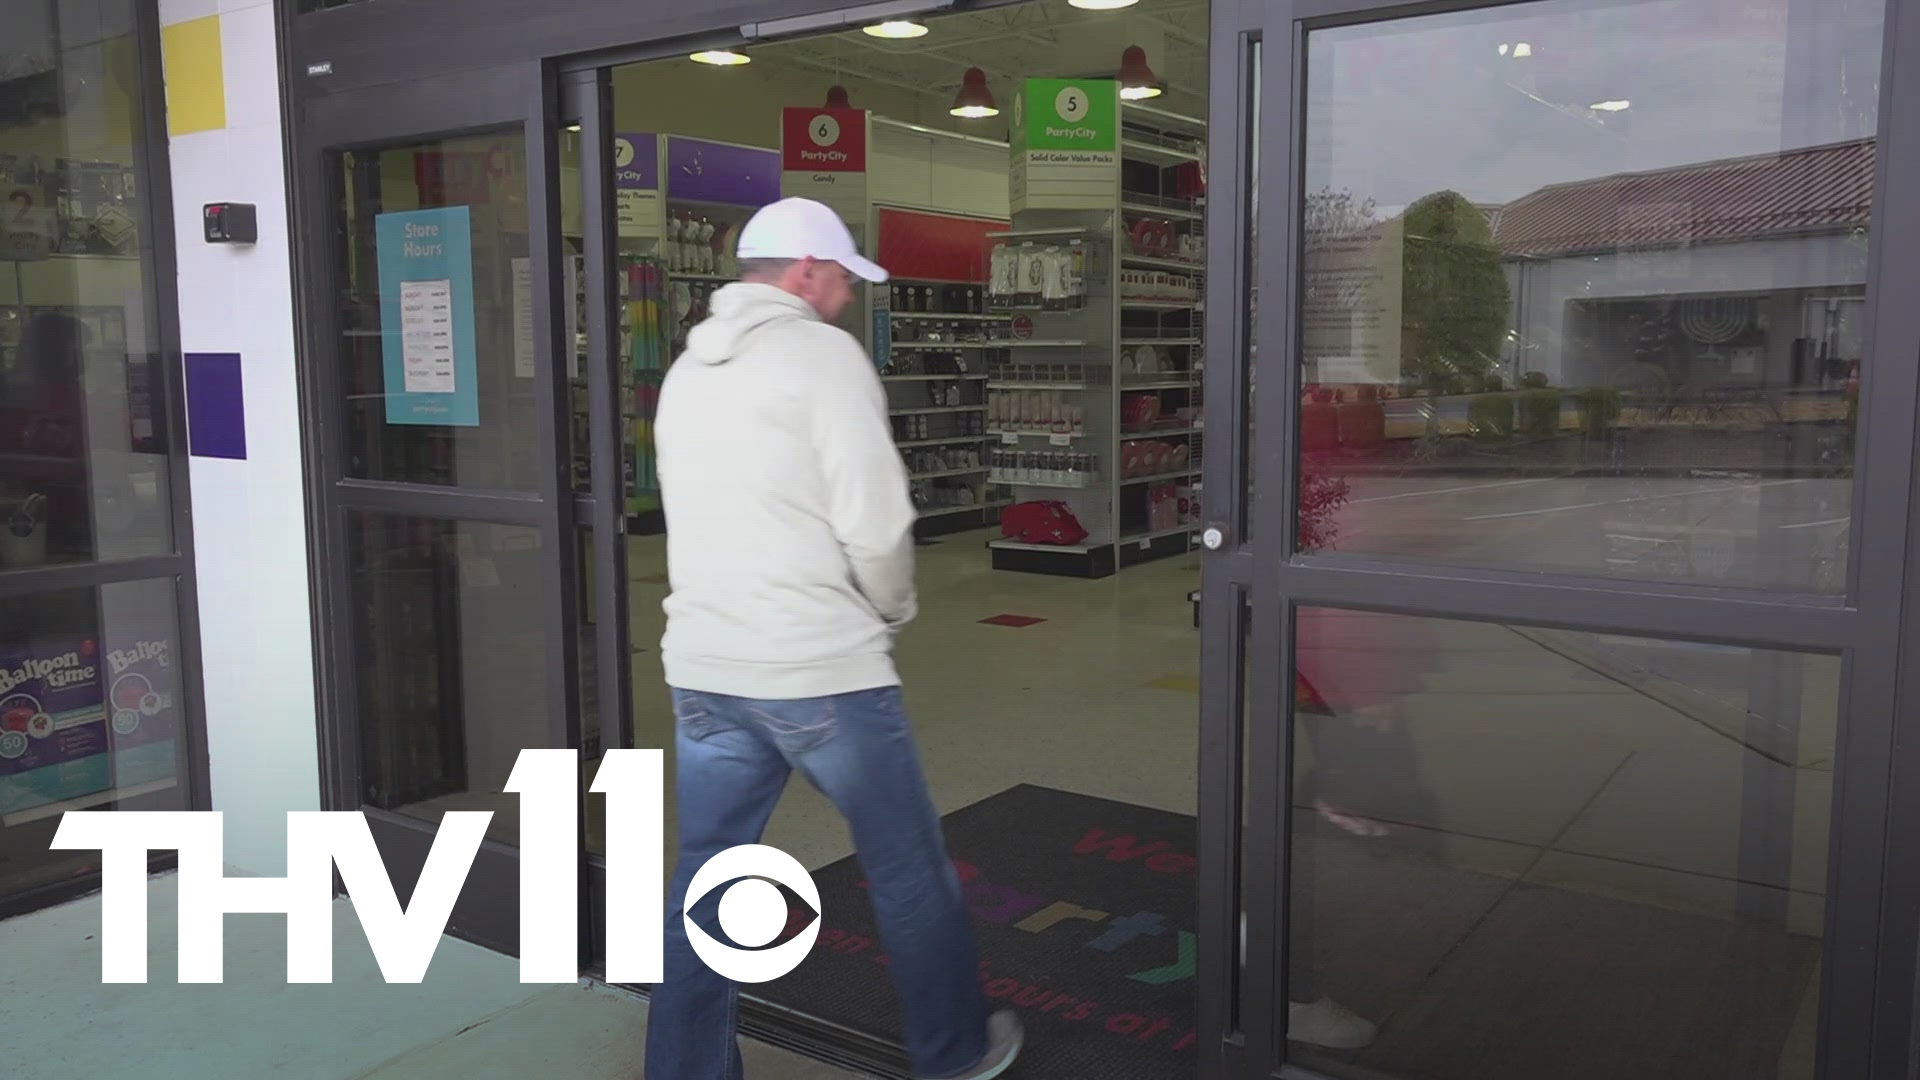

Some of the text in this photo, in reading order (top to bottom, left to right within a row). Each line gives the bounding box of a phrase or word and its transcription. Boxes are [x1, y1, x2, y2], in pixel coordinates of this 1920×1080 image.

[1067, 96, 1077, 112] 5
[818, 123, 828, 138] 6
[1030, 153, 1113, 163] Solid Color Value Packs
[812, 174, 836, 185] Candy
[404, 222, 439, 239] Store
[403, 242, 442, 258] Hours
[106, 640, 168, 675] Ballo
[0, 651, 79, 695] Balloon
[46, 664, 96, 687] time
[2, 736, 22, 751] 50
[1072, 827, 1197, 877] We
[1104, 1012, 1172, 1042] at
